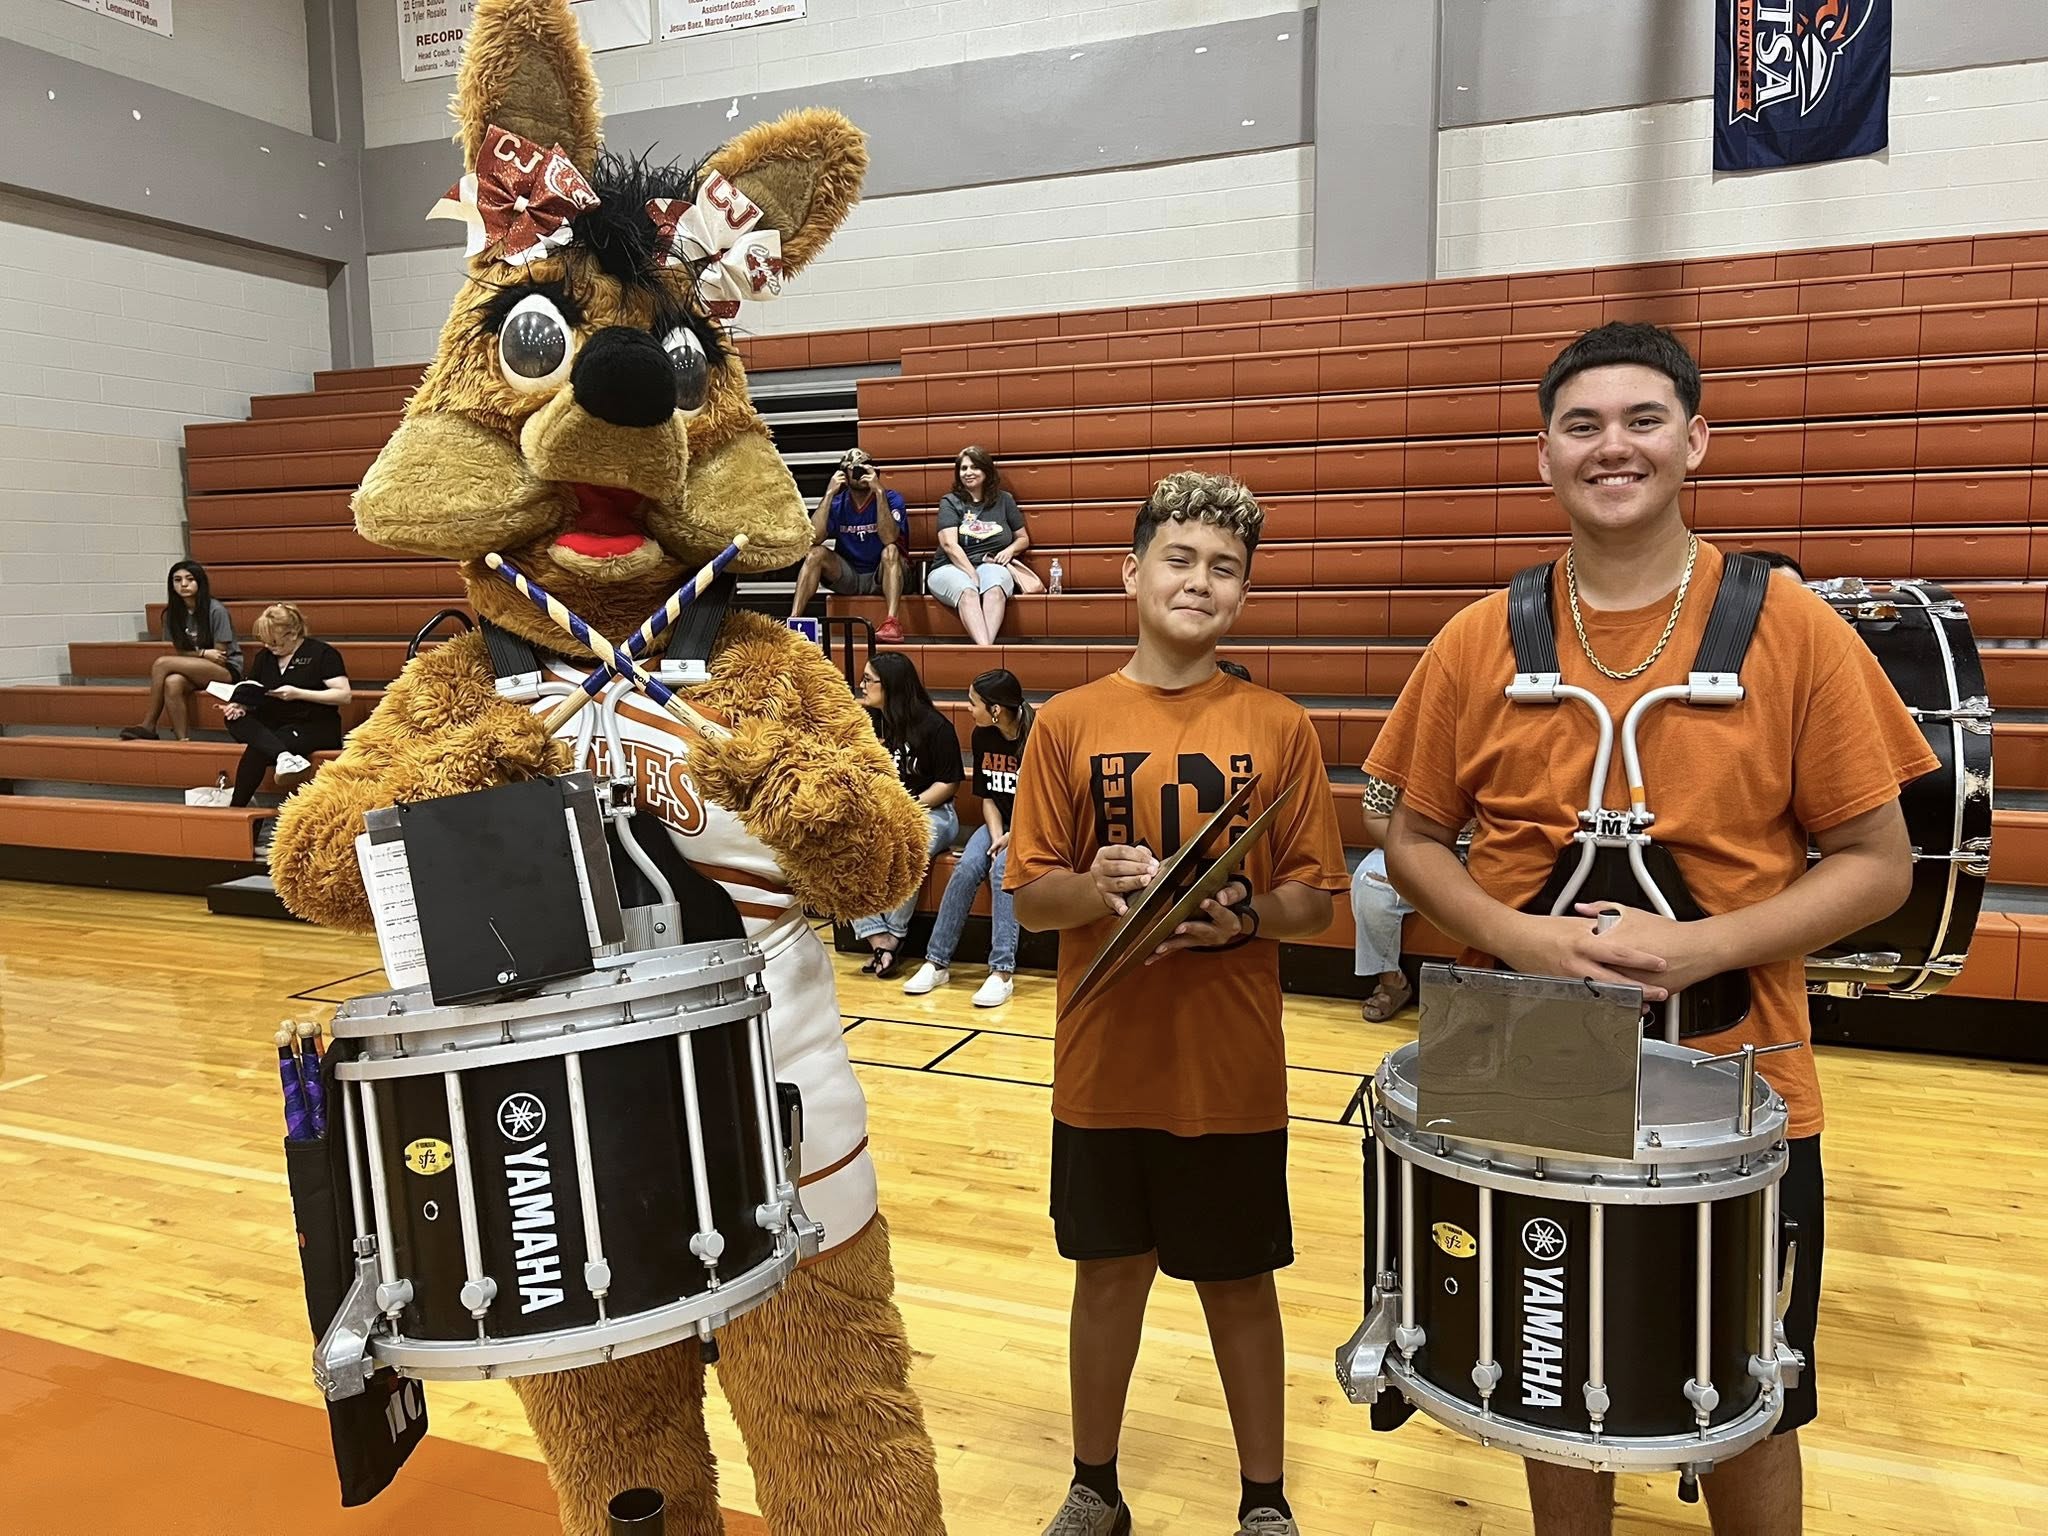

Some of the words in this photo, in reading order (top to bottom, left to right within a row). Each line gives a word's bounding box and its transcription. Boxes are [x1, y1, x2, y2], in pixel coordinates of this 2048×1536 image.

[106, 0, 135, 19] Leonard
[136, 11, 158, 27] Tipton
[404, 13, 411, 23] 23
[669, 24, 687, 33] Jesus
[688, 20, 704, 30] Baez,
[705, 17, 724, 27] Marco
[725, 12, 754, 24] Gonzalez,
[754, 10, 769, 18] Sean
[770, 4, 796, 15] Sullivan
[702, 2, 730, 14] Assistant
[731, 0, 756, 9] Coaches
[416, 29, 463, 47] RECORD
[414, 63, 438, 73] Assistants
[417, 51, 432, 60] Head
[433, 49, 450, 57] Coach
[494, 133, 543, 174] CJ
[705, 174, 760, 231] CJ
[981, 752, 1018, 773] AHS
[1101, 756, 1127, 845] OTES
[504, 1142, 564, 1314] YAMAHA
[1522, 1267, 1564, 1407] YAMAHA
